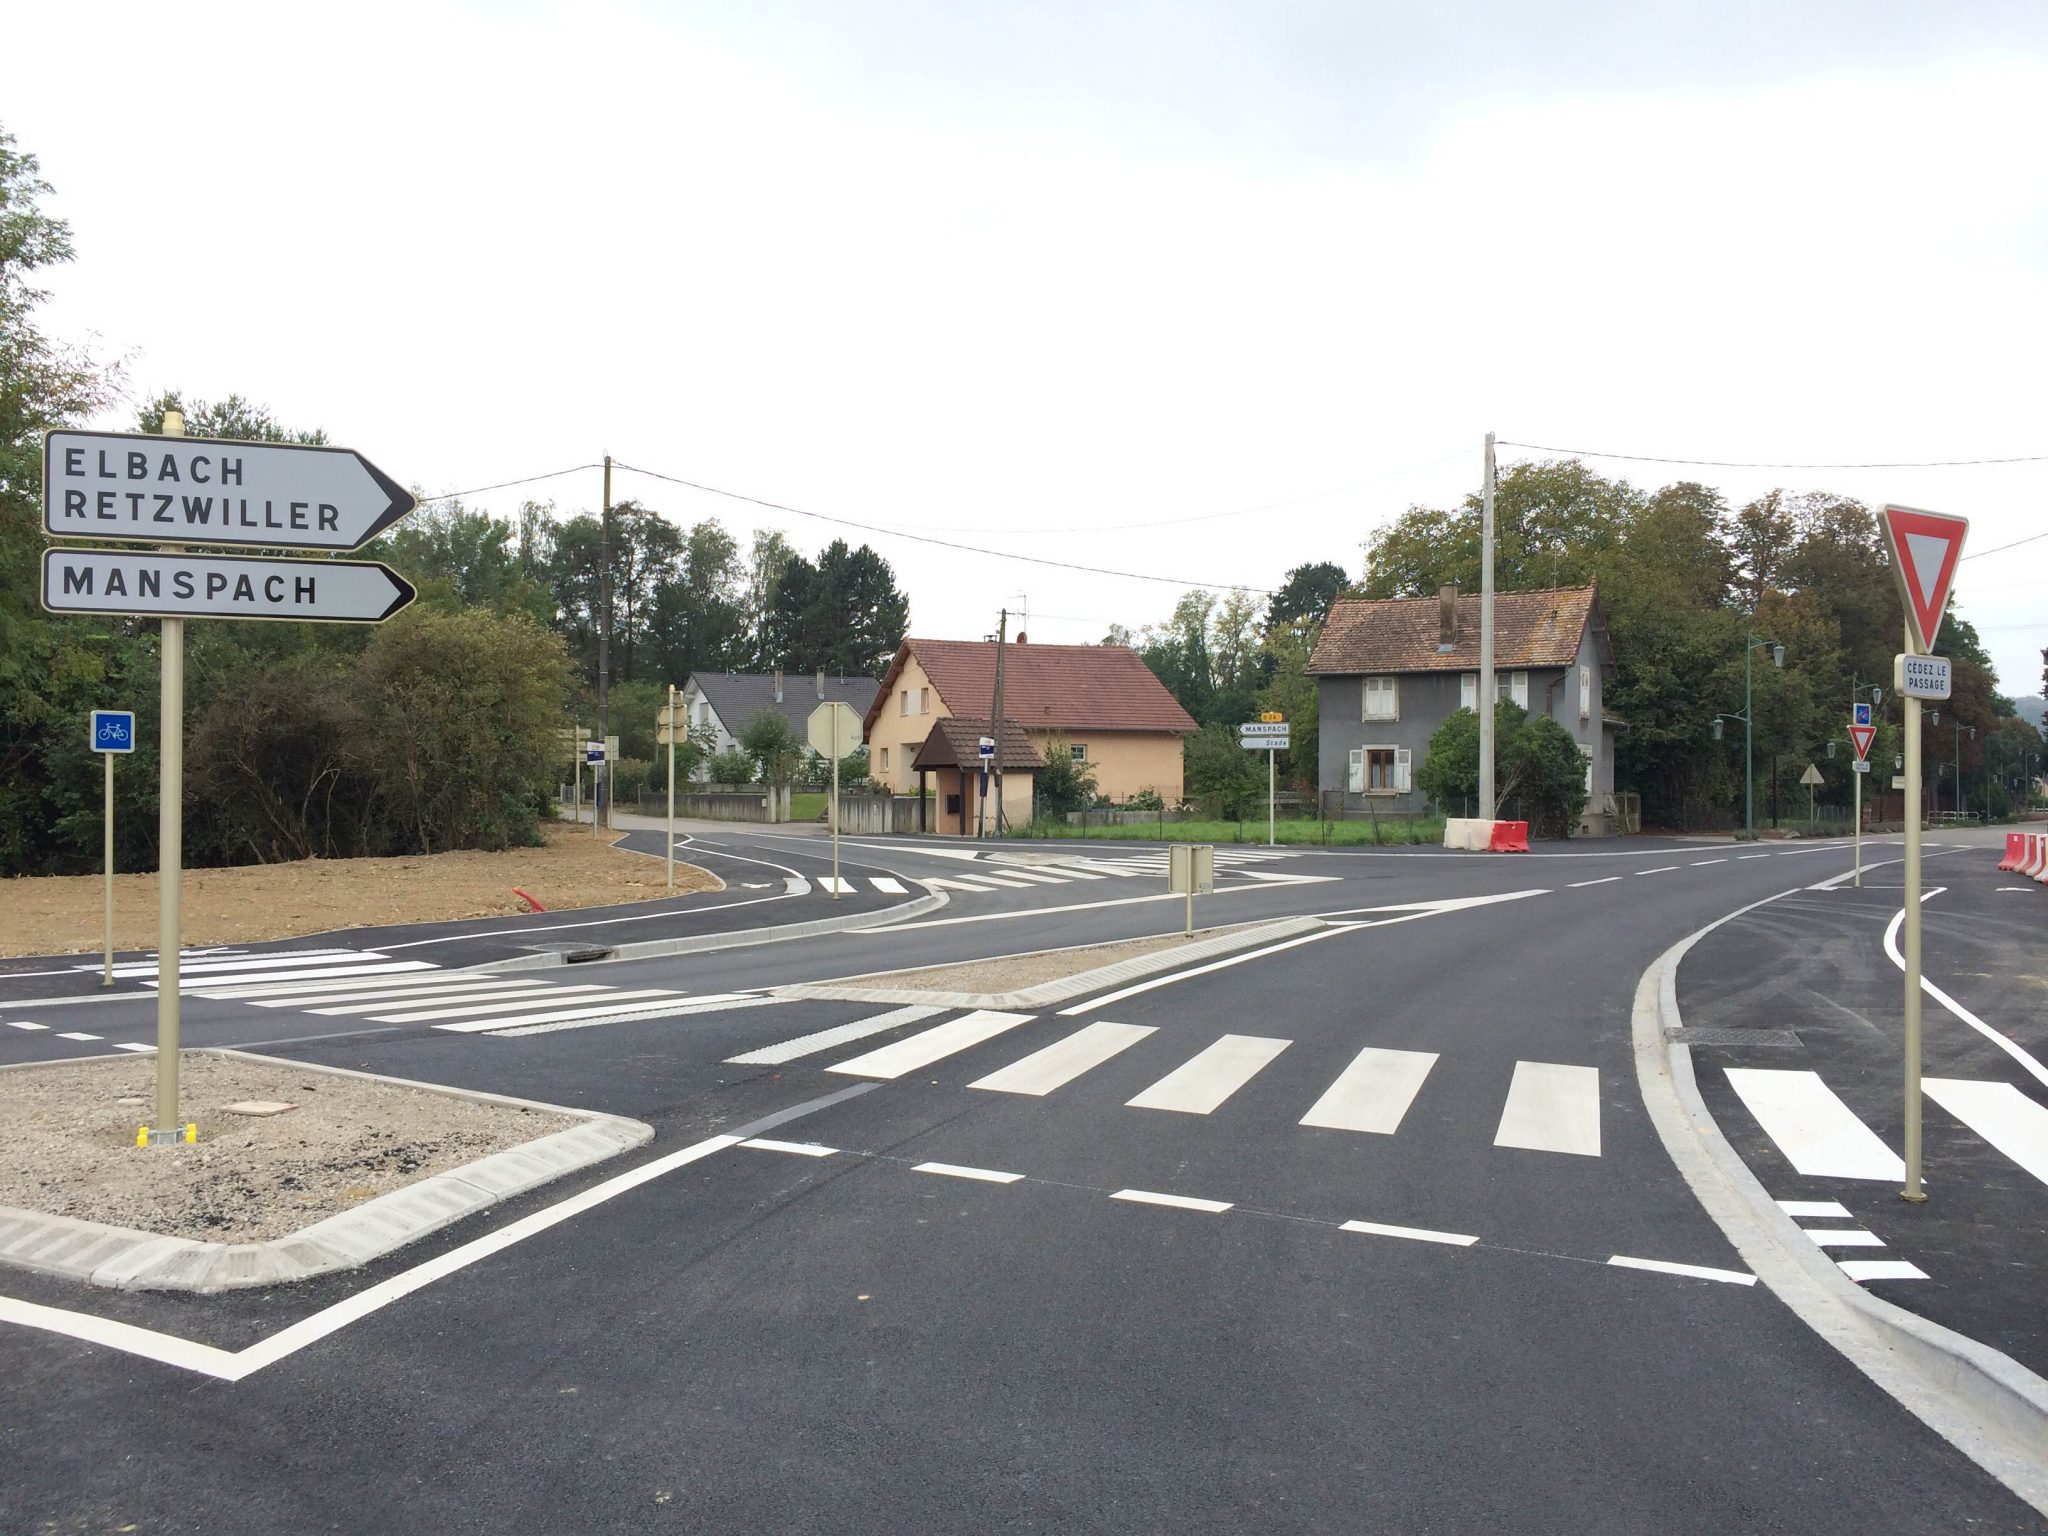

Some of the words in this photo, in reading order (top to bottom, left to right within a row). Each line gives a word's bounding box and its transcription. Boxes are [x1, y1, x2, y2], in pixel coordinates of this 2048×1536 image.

[65, 448, 243, 486] ELBACH
[64, 489, 339, 532] RETZWILLER
[63, 565, 316, 604] MANSPACH
[1907, 661, 1934, 676] CÉDEZ
[1937, 665, 1946, 677] LE
[1909, 677, 1945, 691] PASSAGE
